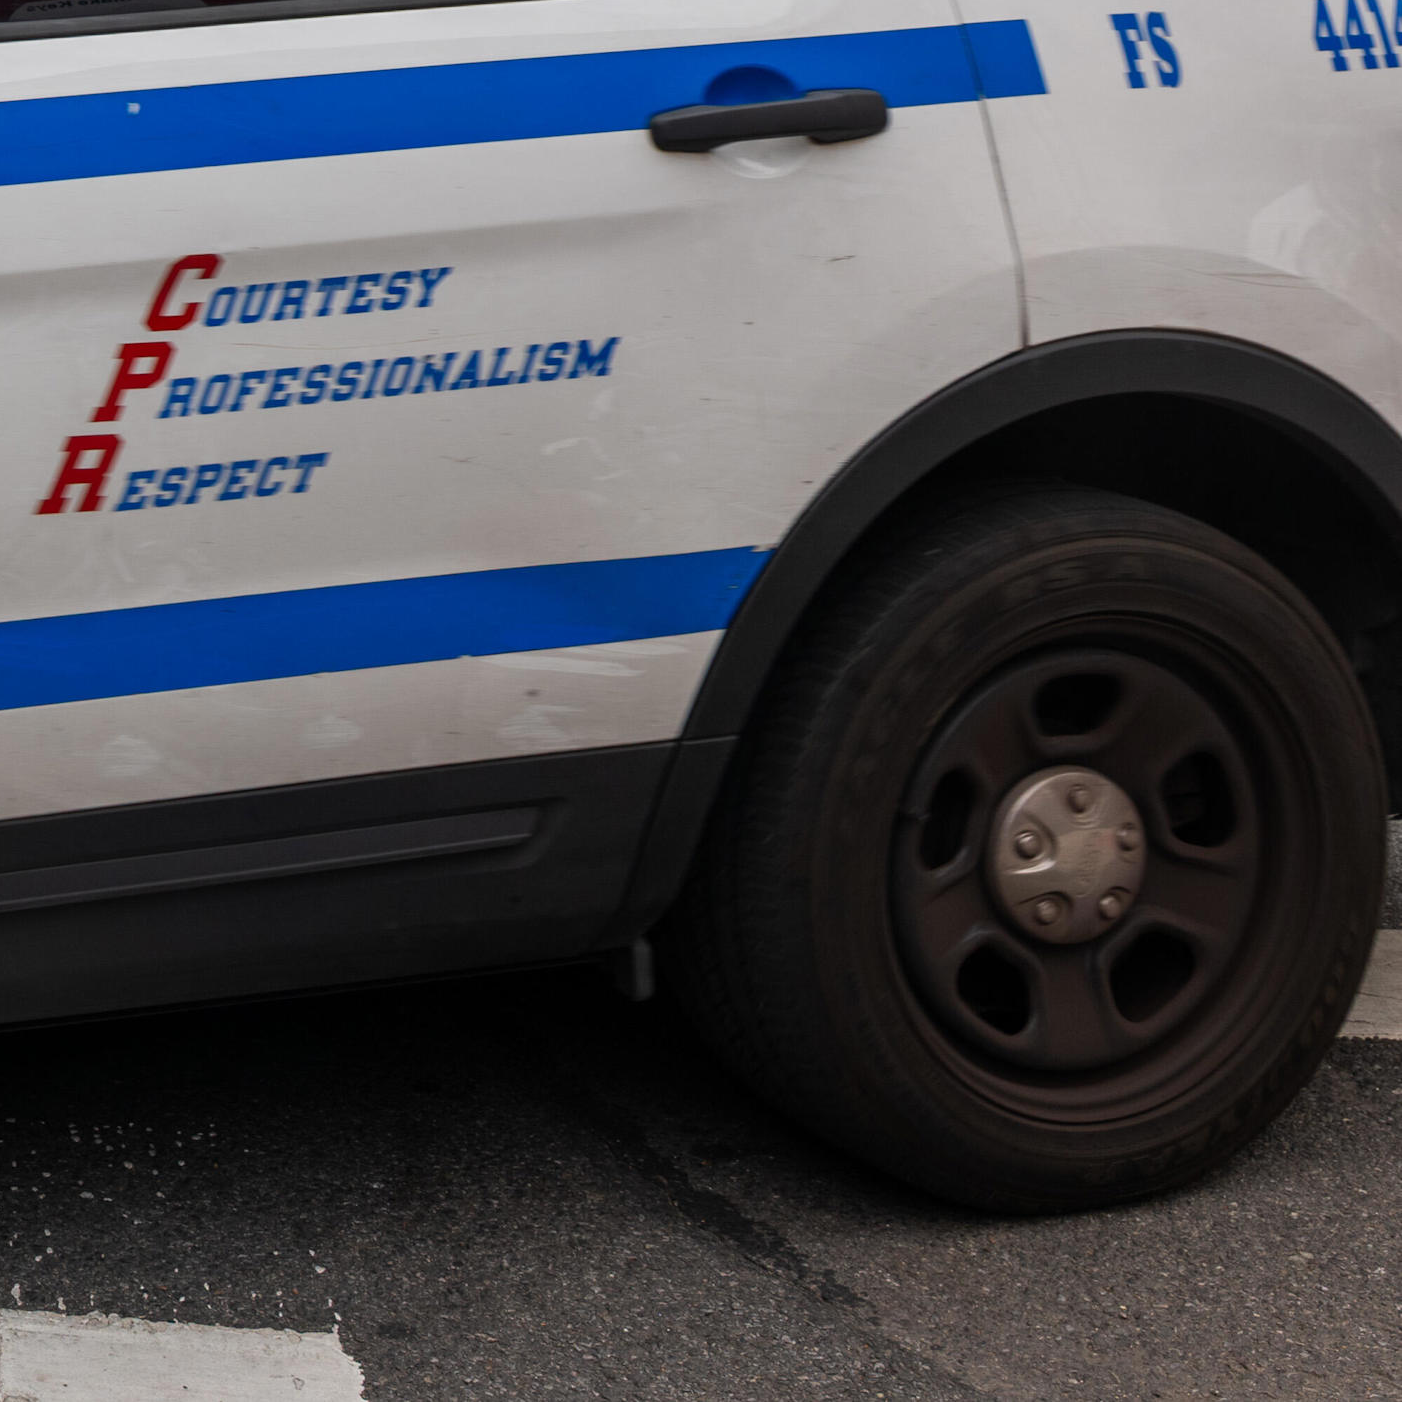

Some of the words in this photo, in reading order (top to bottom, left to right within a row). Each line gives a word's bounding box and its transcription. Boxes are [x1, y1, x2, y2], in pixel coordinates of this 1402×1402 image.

[1108, 11, 1184, 90] FS
[142, 253, 454, 332] COURTESY
[87, 336, 623, 423] PROFESSIONALISM
[32, 433, 332, 516] RESPECT
